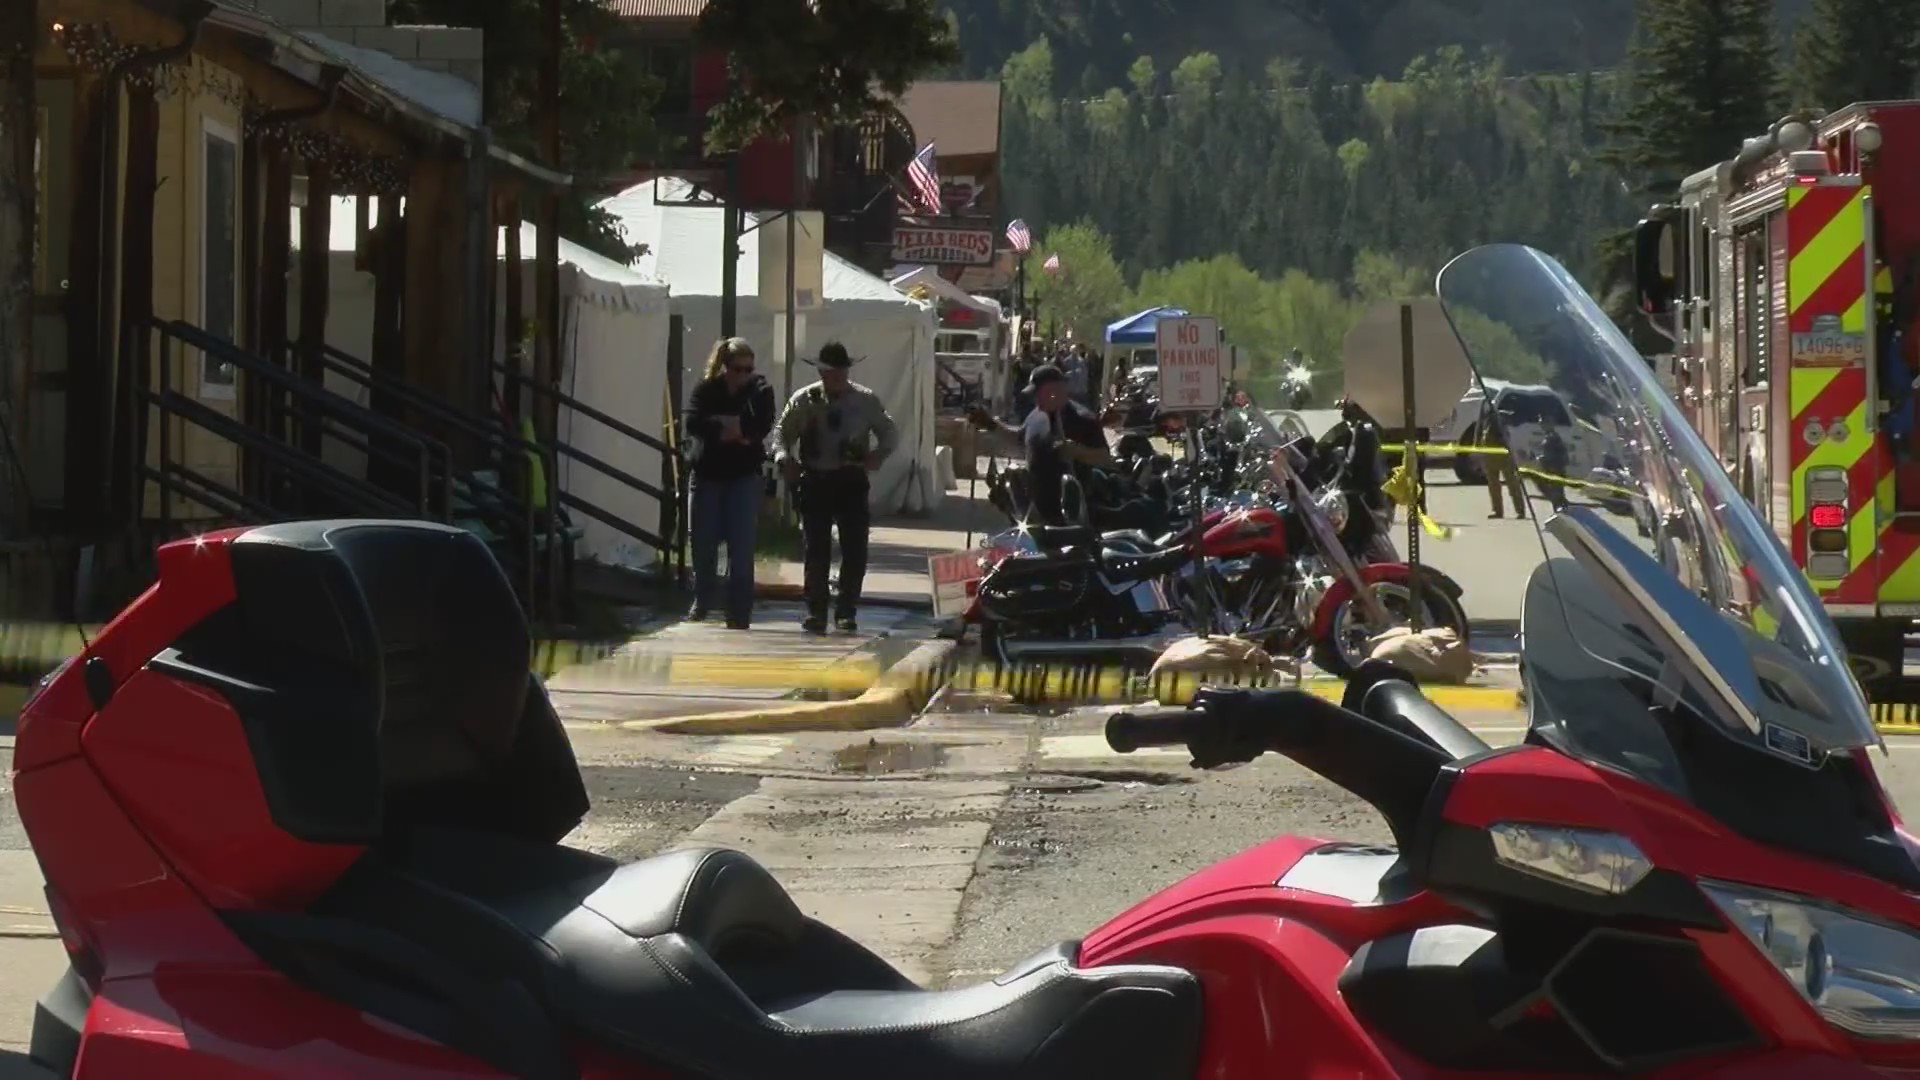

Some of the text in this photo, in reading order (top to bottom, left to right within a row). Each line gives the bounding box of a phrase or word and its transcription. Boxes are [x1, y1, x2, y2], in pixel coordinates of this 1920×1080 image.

[896, 231, 990, 256] TEXAS REDS
[1177, 324, 1199, 345] NO
[1162, 347, 1217, 367] PARKING
